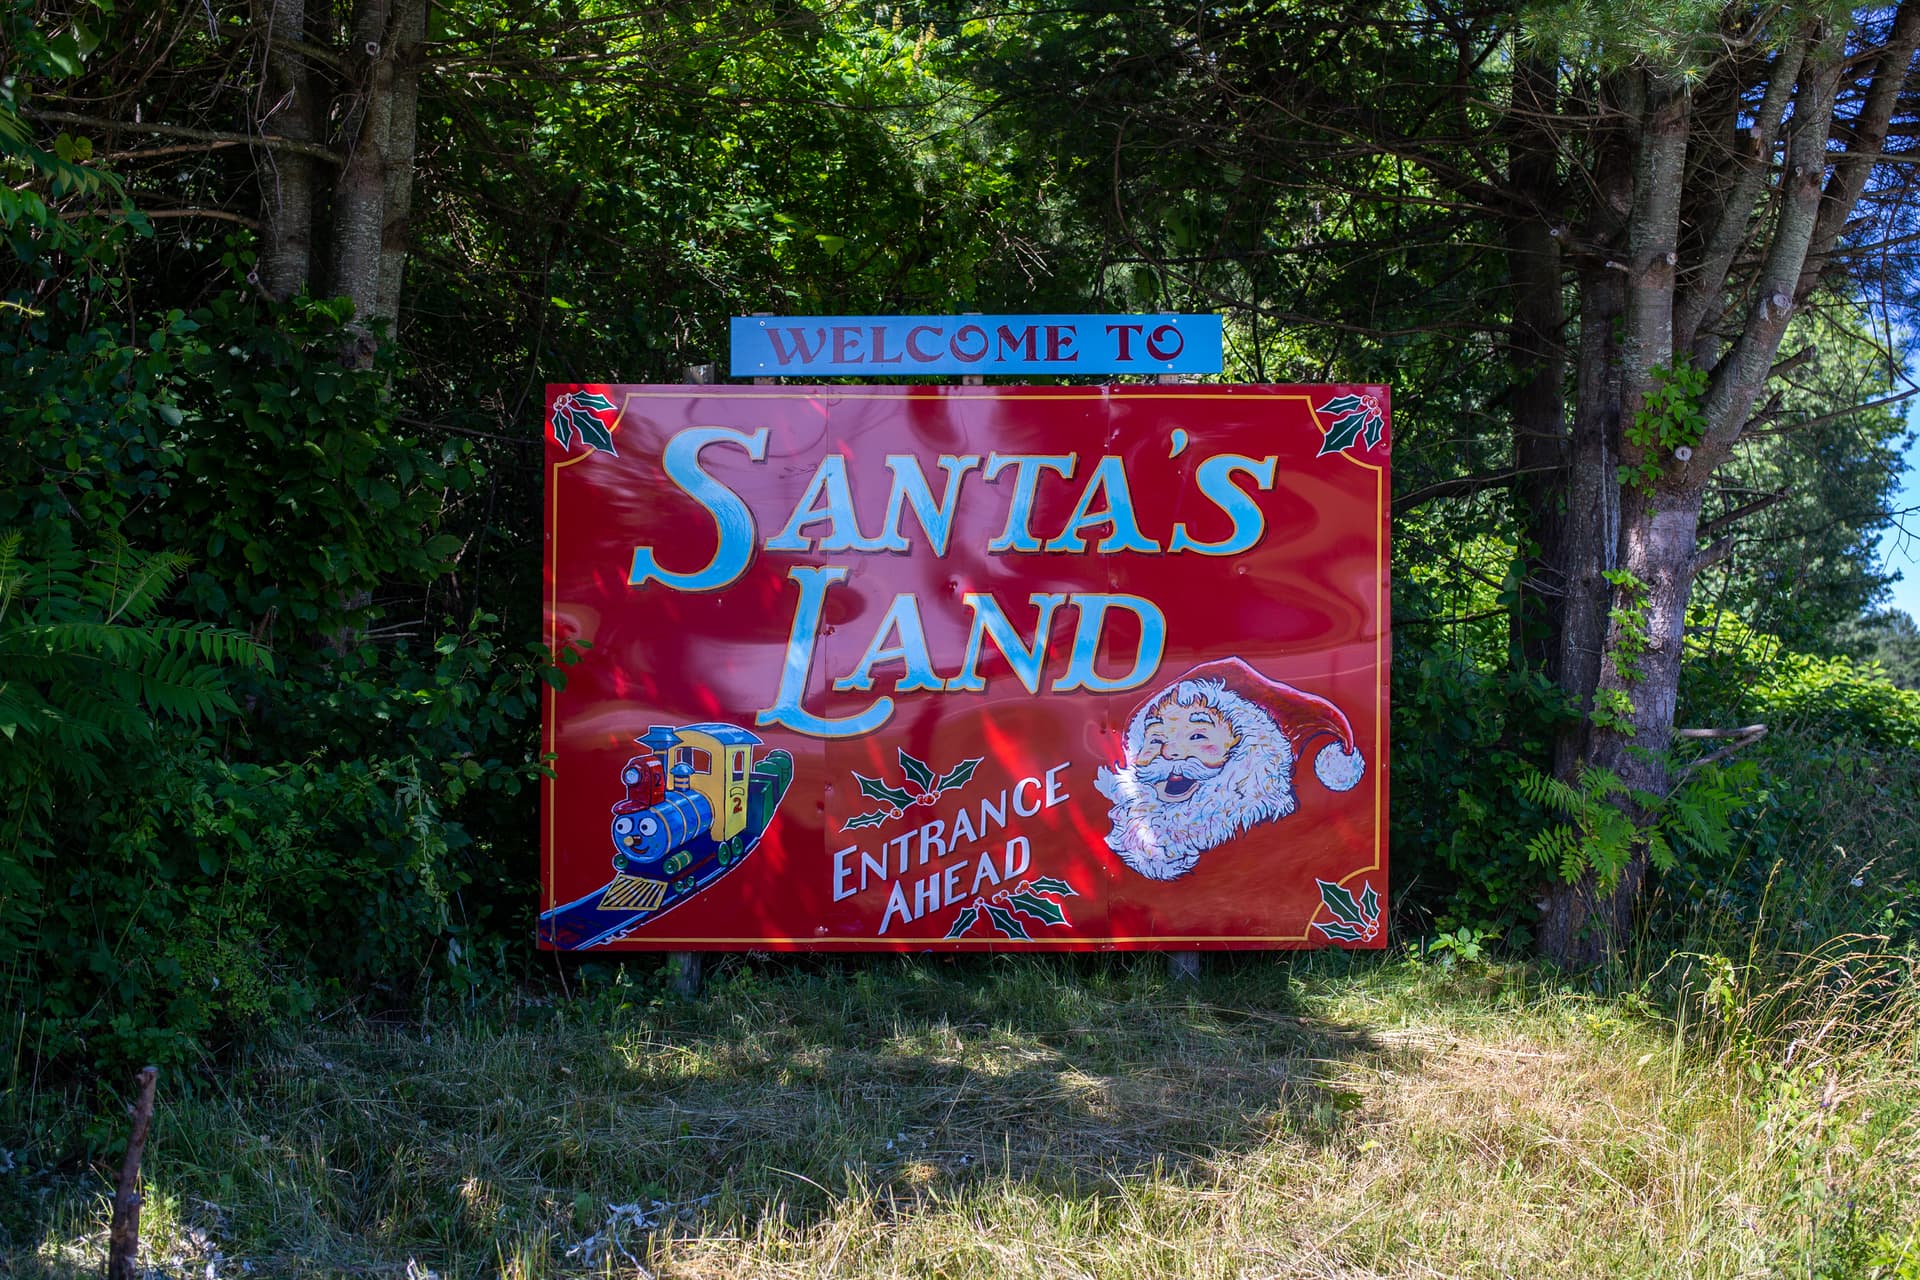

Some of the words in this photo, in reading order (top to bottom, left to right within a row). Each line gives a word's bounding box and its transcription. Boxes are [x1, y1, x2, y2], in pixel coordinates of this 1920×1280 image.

[766, 324, 1079, 366] WELCOME
[1105, 323, 1185, 362] TO
[628, 427, 1279, 593] SANTA'S
[755, 565, 1167, 739] LAND
[654, 772, 663, 788] 2
[732, 796, 744, 815] 2
[833, 761, 1072, 903] ENTRANCE
[877, 836, 1032, 936] AHEAD
